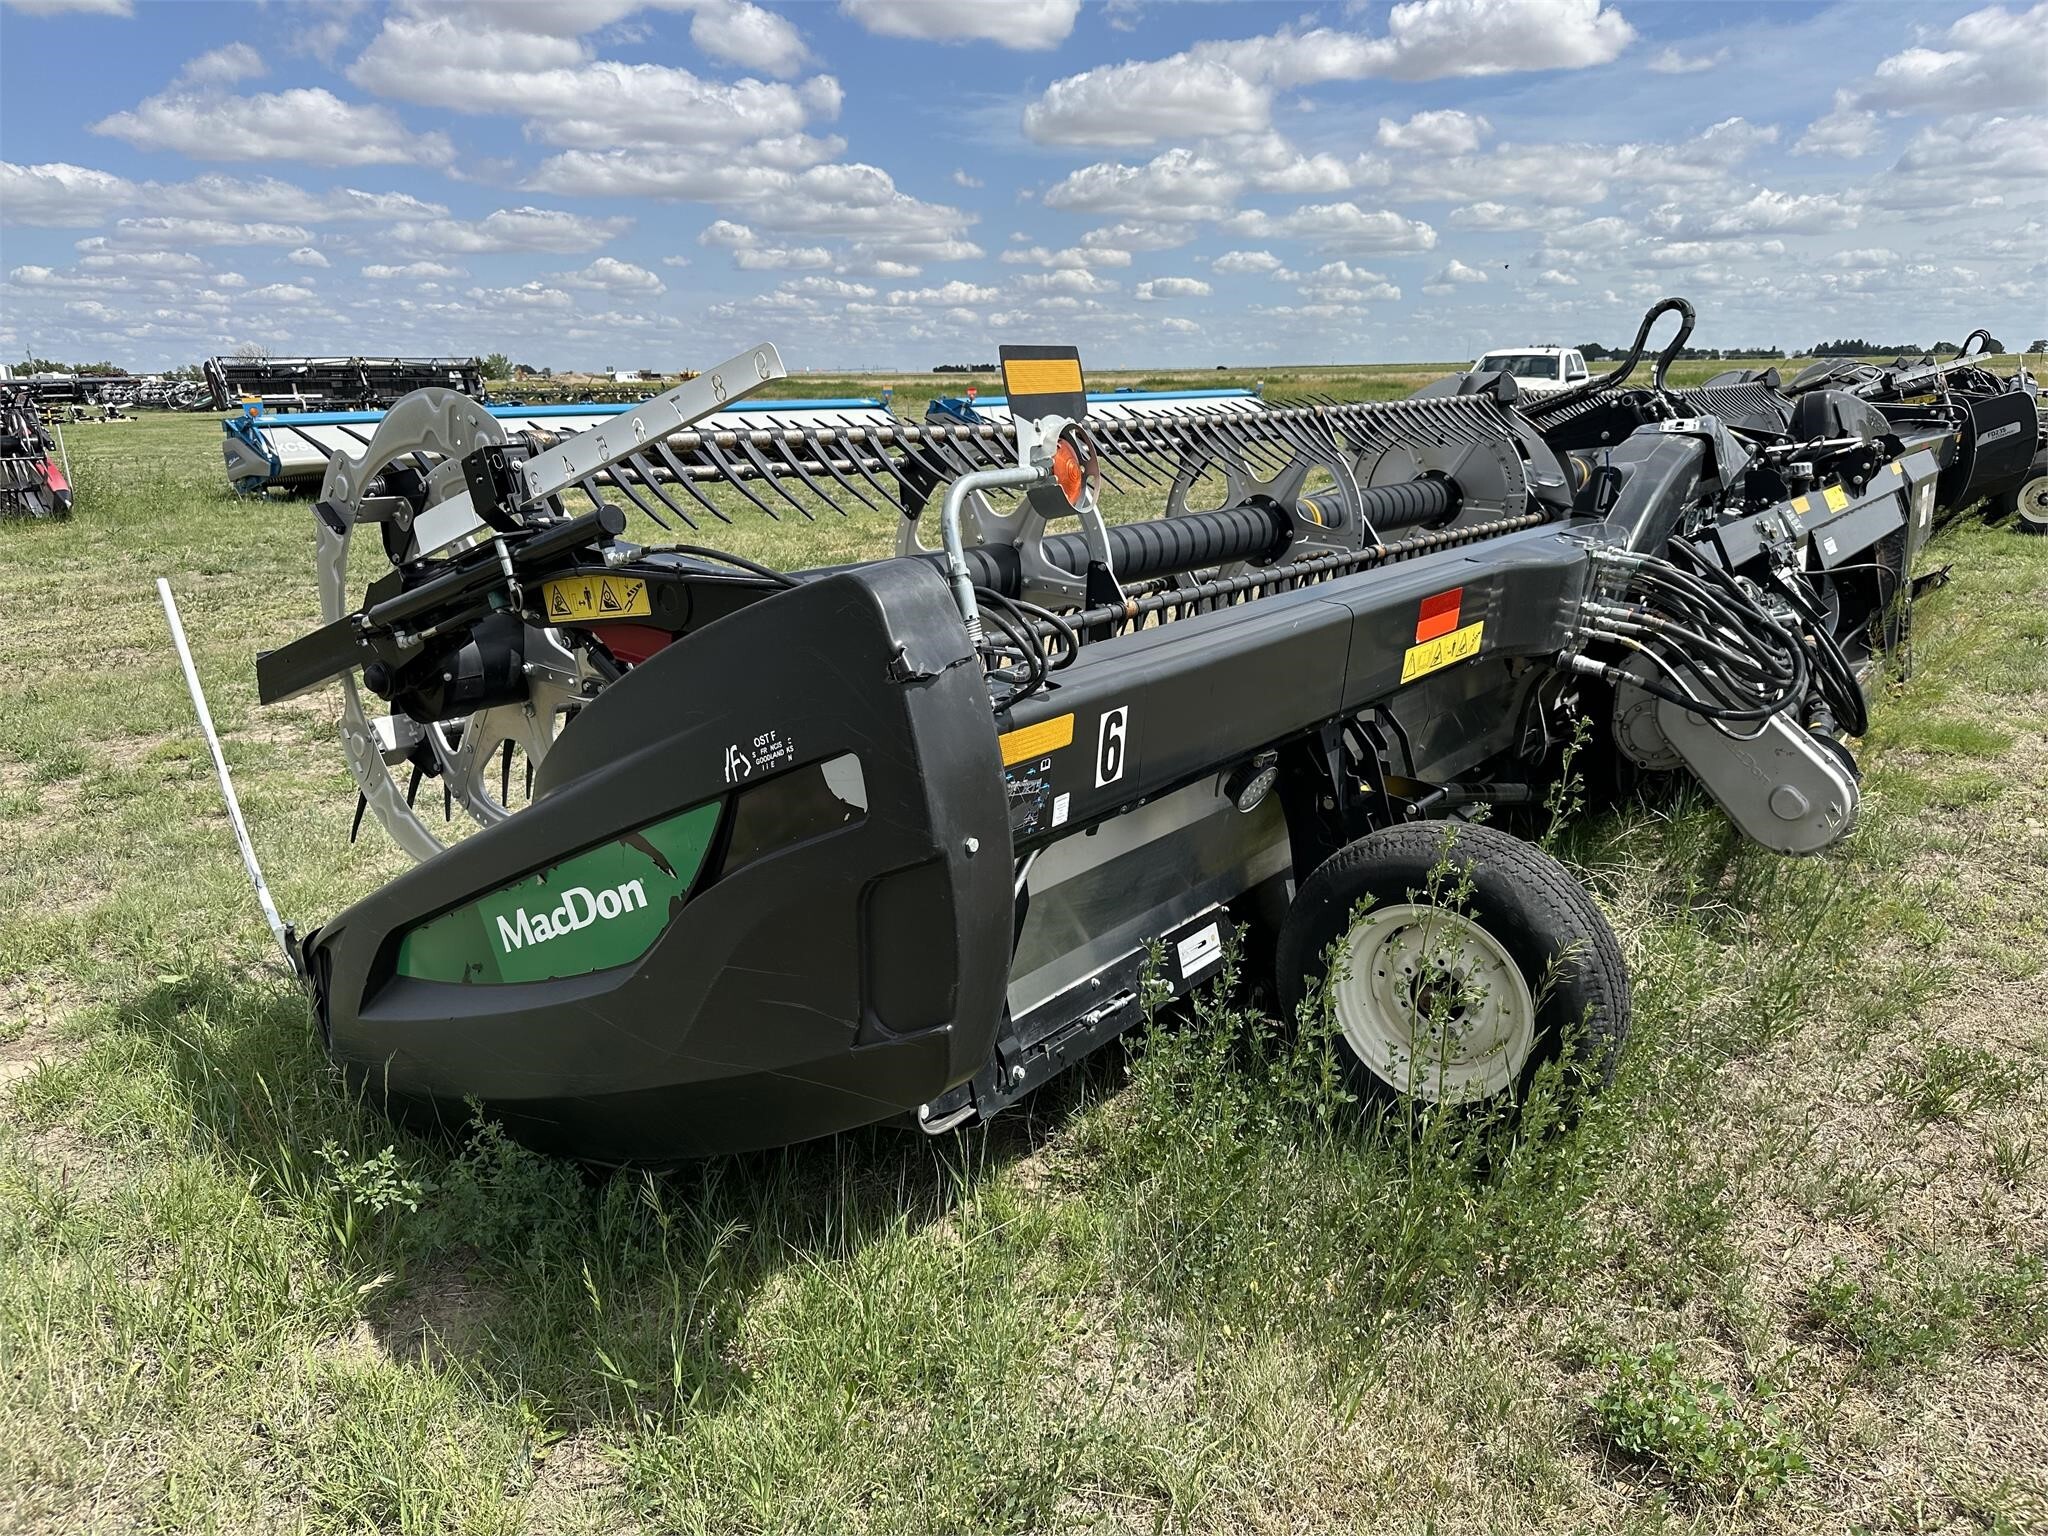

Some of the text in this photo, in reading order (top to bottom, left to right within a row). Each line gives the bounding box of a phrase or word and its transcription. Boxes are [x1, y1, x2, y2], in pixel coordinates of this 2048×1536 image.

[755, 748, 785, 765] GOODLAND
[1100, 710, 1123, 783] 6
[496, 878, 649, 953] MacDon
